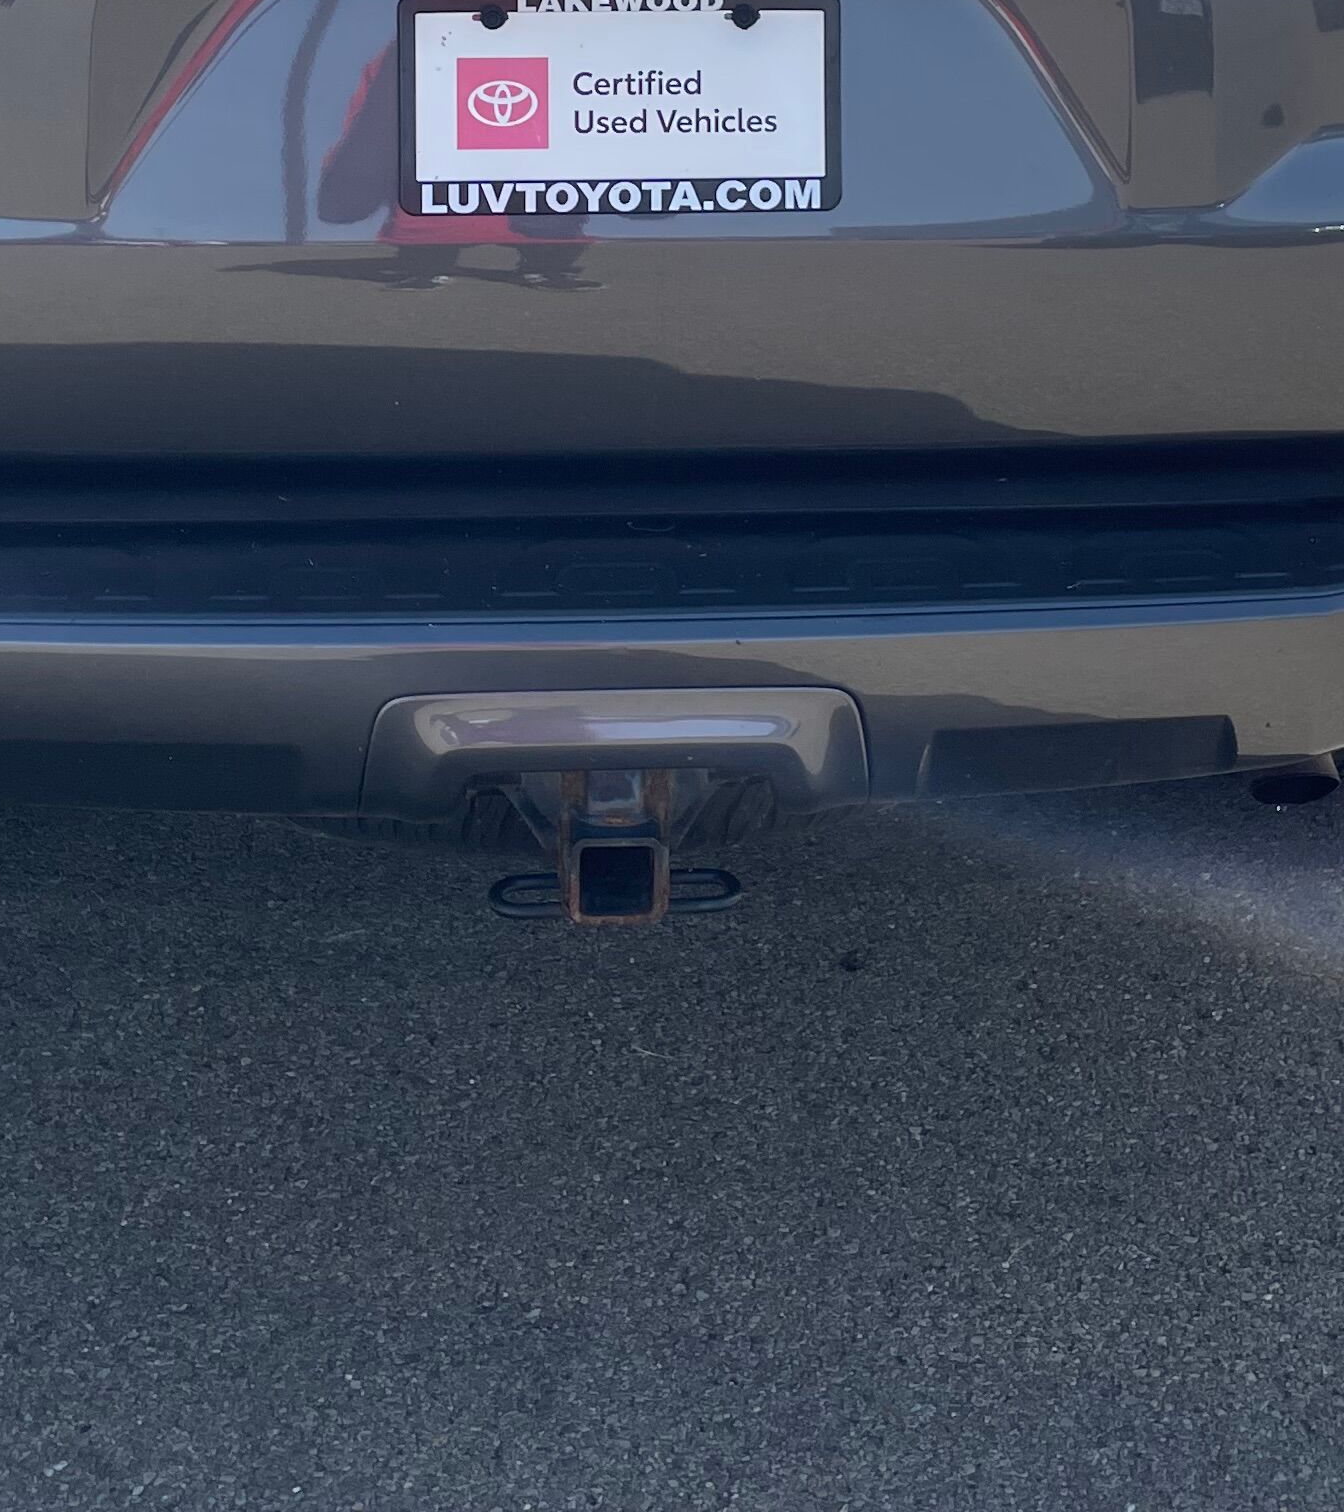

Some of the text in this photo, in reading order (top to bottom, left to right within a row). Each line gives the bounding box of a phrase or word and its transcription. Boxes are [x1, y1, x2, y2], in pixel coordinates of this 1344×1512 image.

[573, 70, 702, 96] Certified
[574, 108, 777, 135] Used Vehicles
[420, 178, 822, 215] LUVTOYOTA.COM
